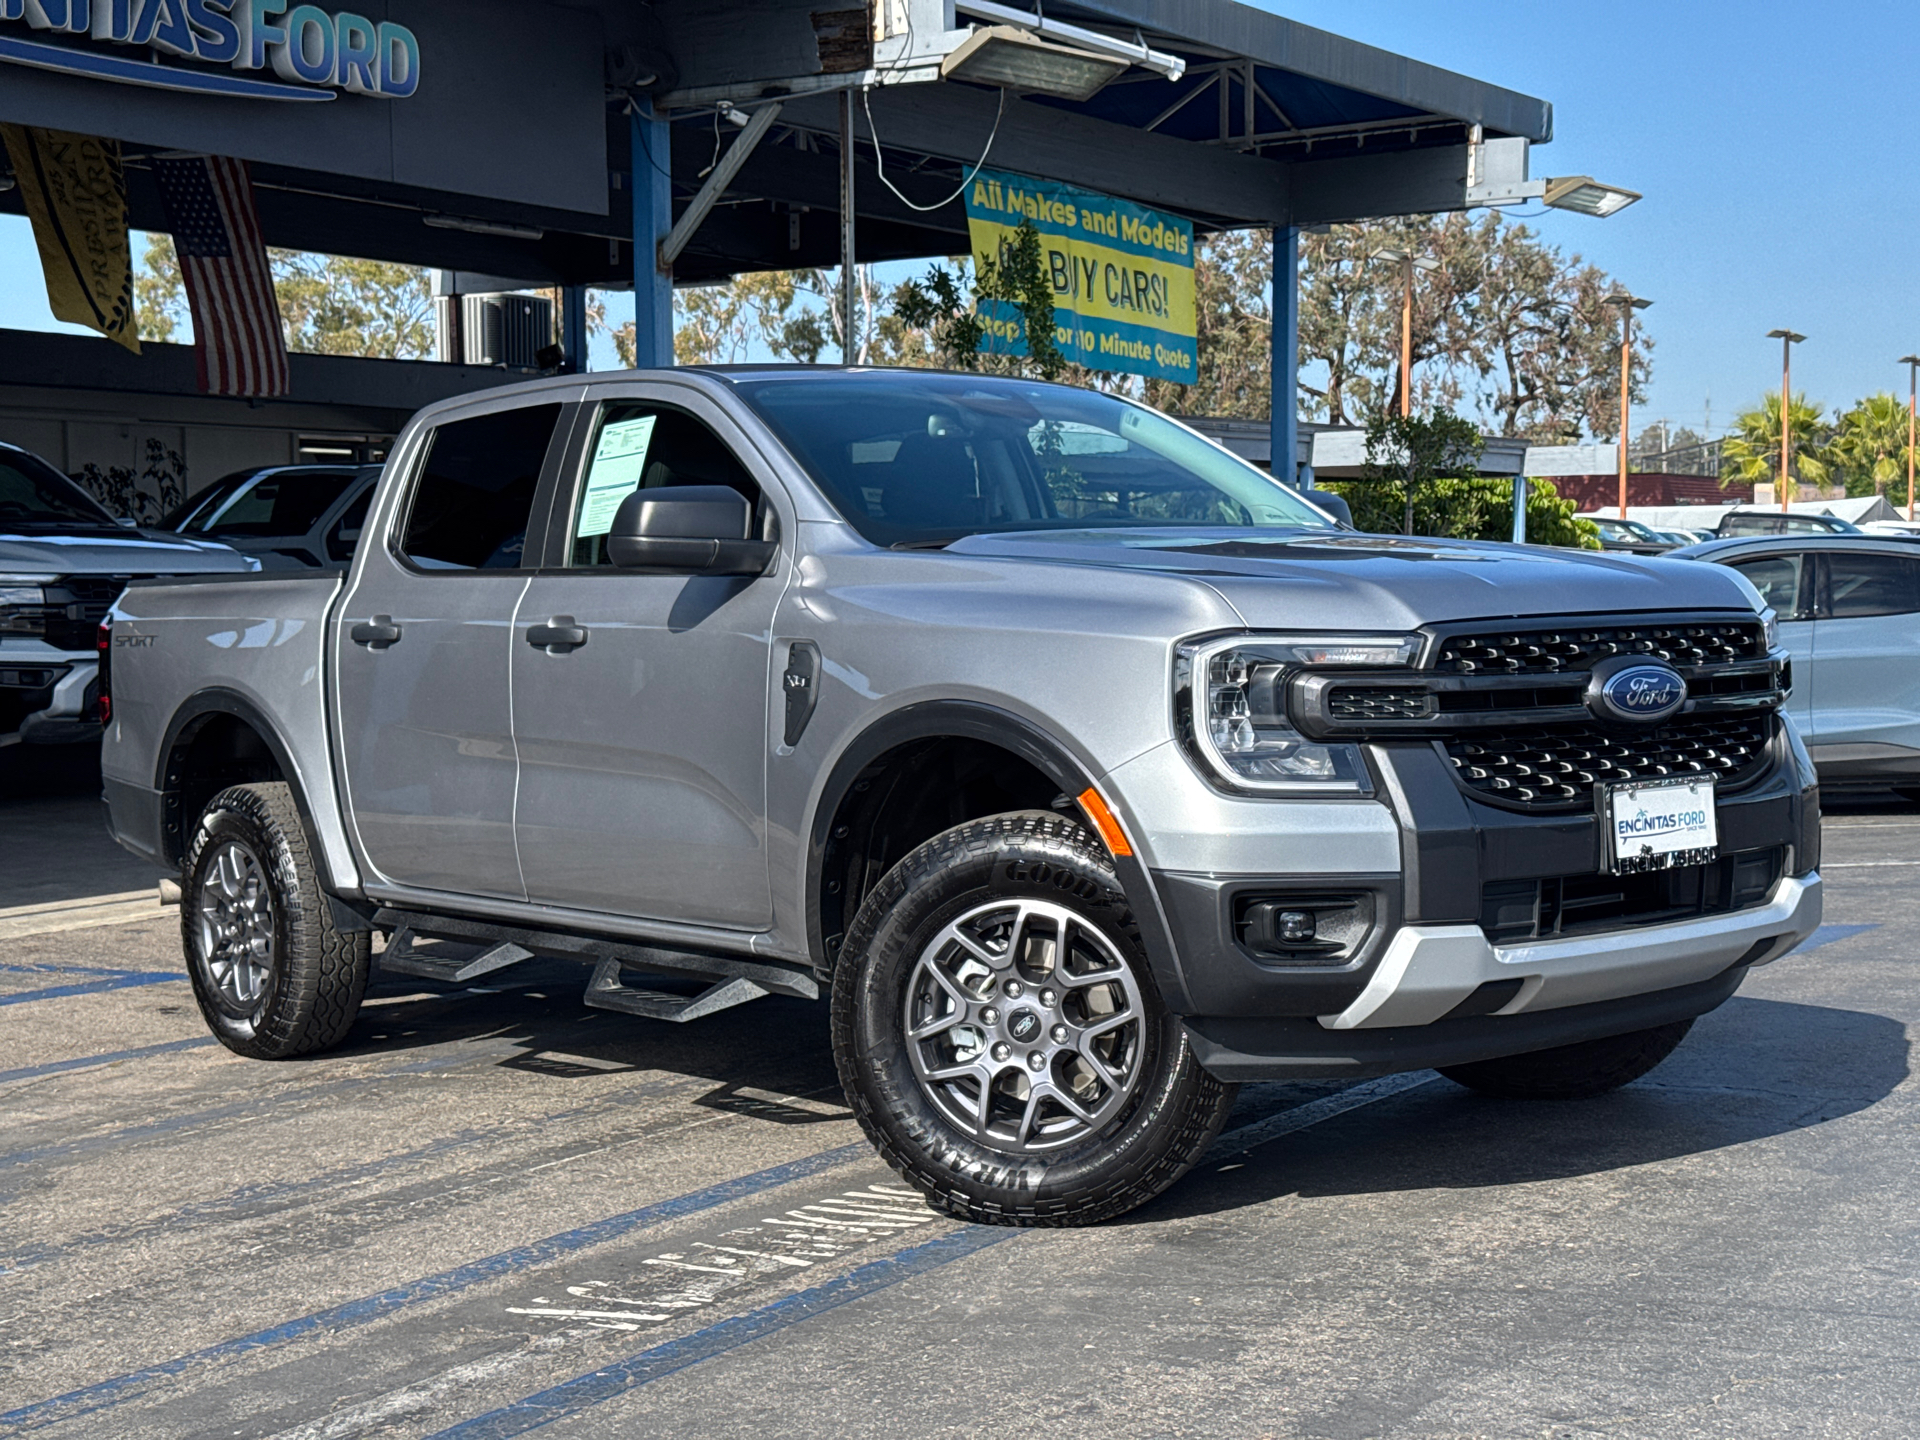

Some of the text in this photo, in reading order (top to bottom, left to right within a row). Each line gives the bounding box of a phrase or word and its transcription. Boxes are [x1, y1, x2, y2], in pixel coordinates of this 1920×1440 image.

[241, 0, 420, 98] FORD
[973, 179, 1188, 255] All Makes and Models
[1048, 250, 1097, 302] BUY
[1105, 263, 1169, 318] CARS!
[974, 314, 1020, 343] Stop
[1050, 321, 1073, 345] or
[1100, 331, 1151, 361] Minute
[1155, 343, 1190, 369] Quote
[115, 635, 159, 647] SPORT
[1626, 677, 1672, 706] Ford
[1618, 810, 1706, 835] ENCINITAS FORD
[871, 1057, 1029, 1191] WRANGLER
